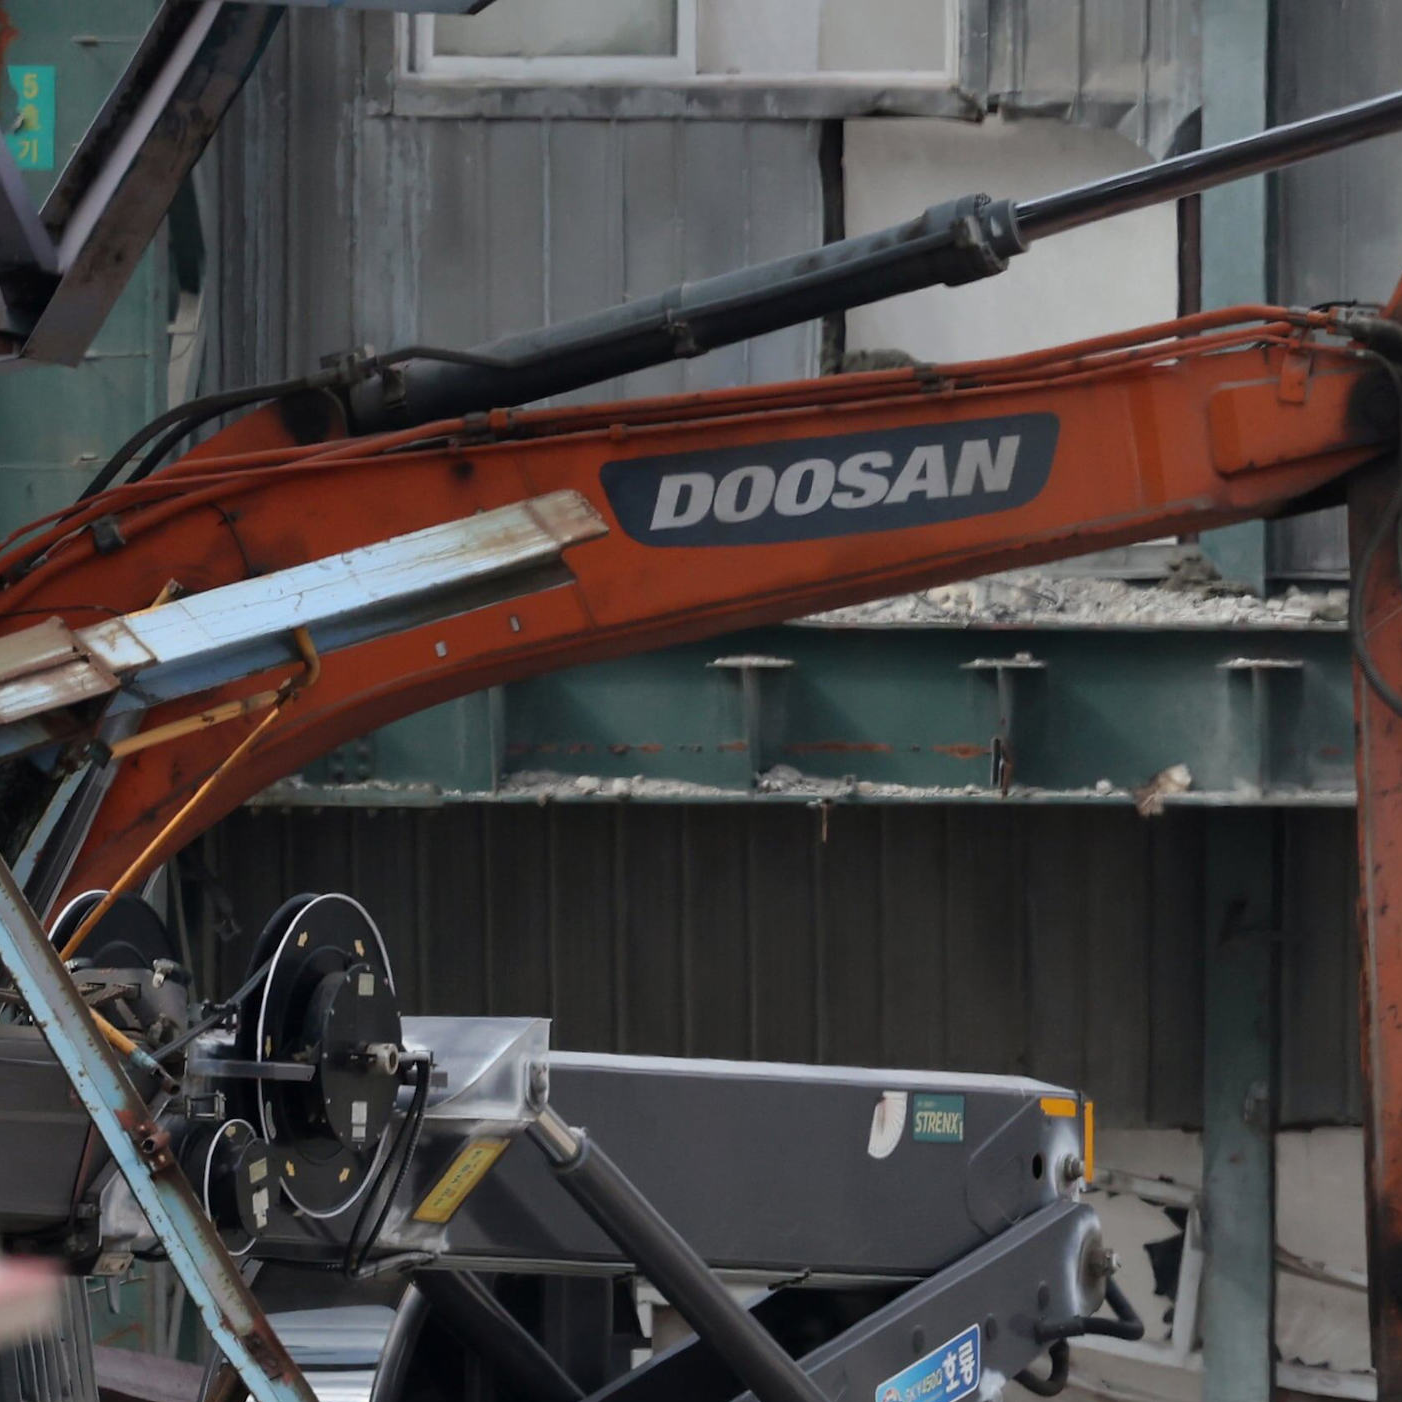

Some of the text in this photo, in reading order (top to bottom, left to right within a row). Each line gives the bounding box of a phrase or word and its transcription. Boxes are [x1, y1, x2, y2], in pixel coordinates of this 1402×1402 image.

[650, 435, 1021, 531] DOOSAN
[914, 1111, 958, 1134] STRENX
[942, 1340, 975, 1394] 호룡
